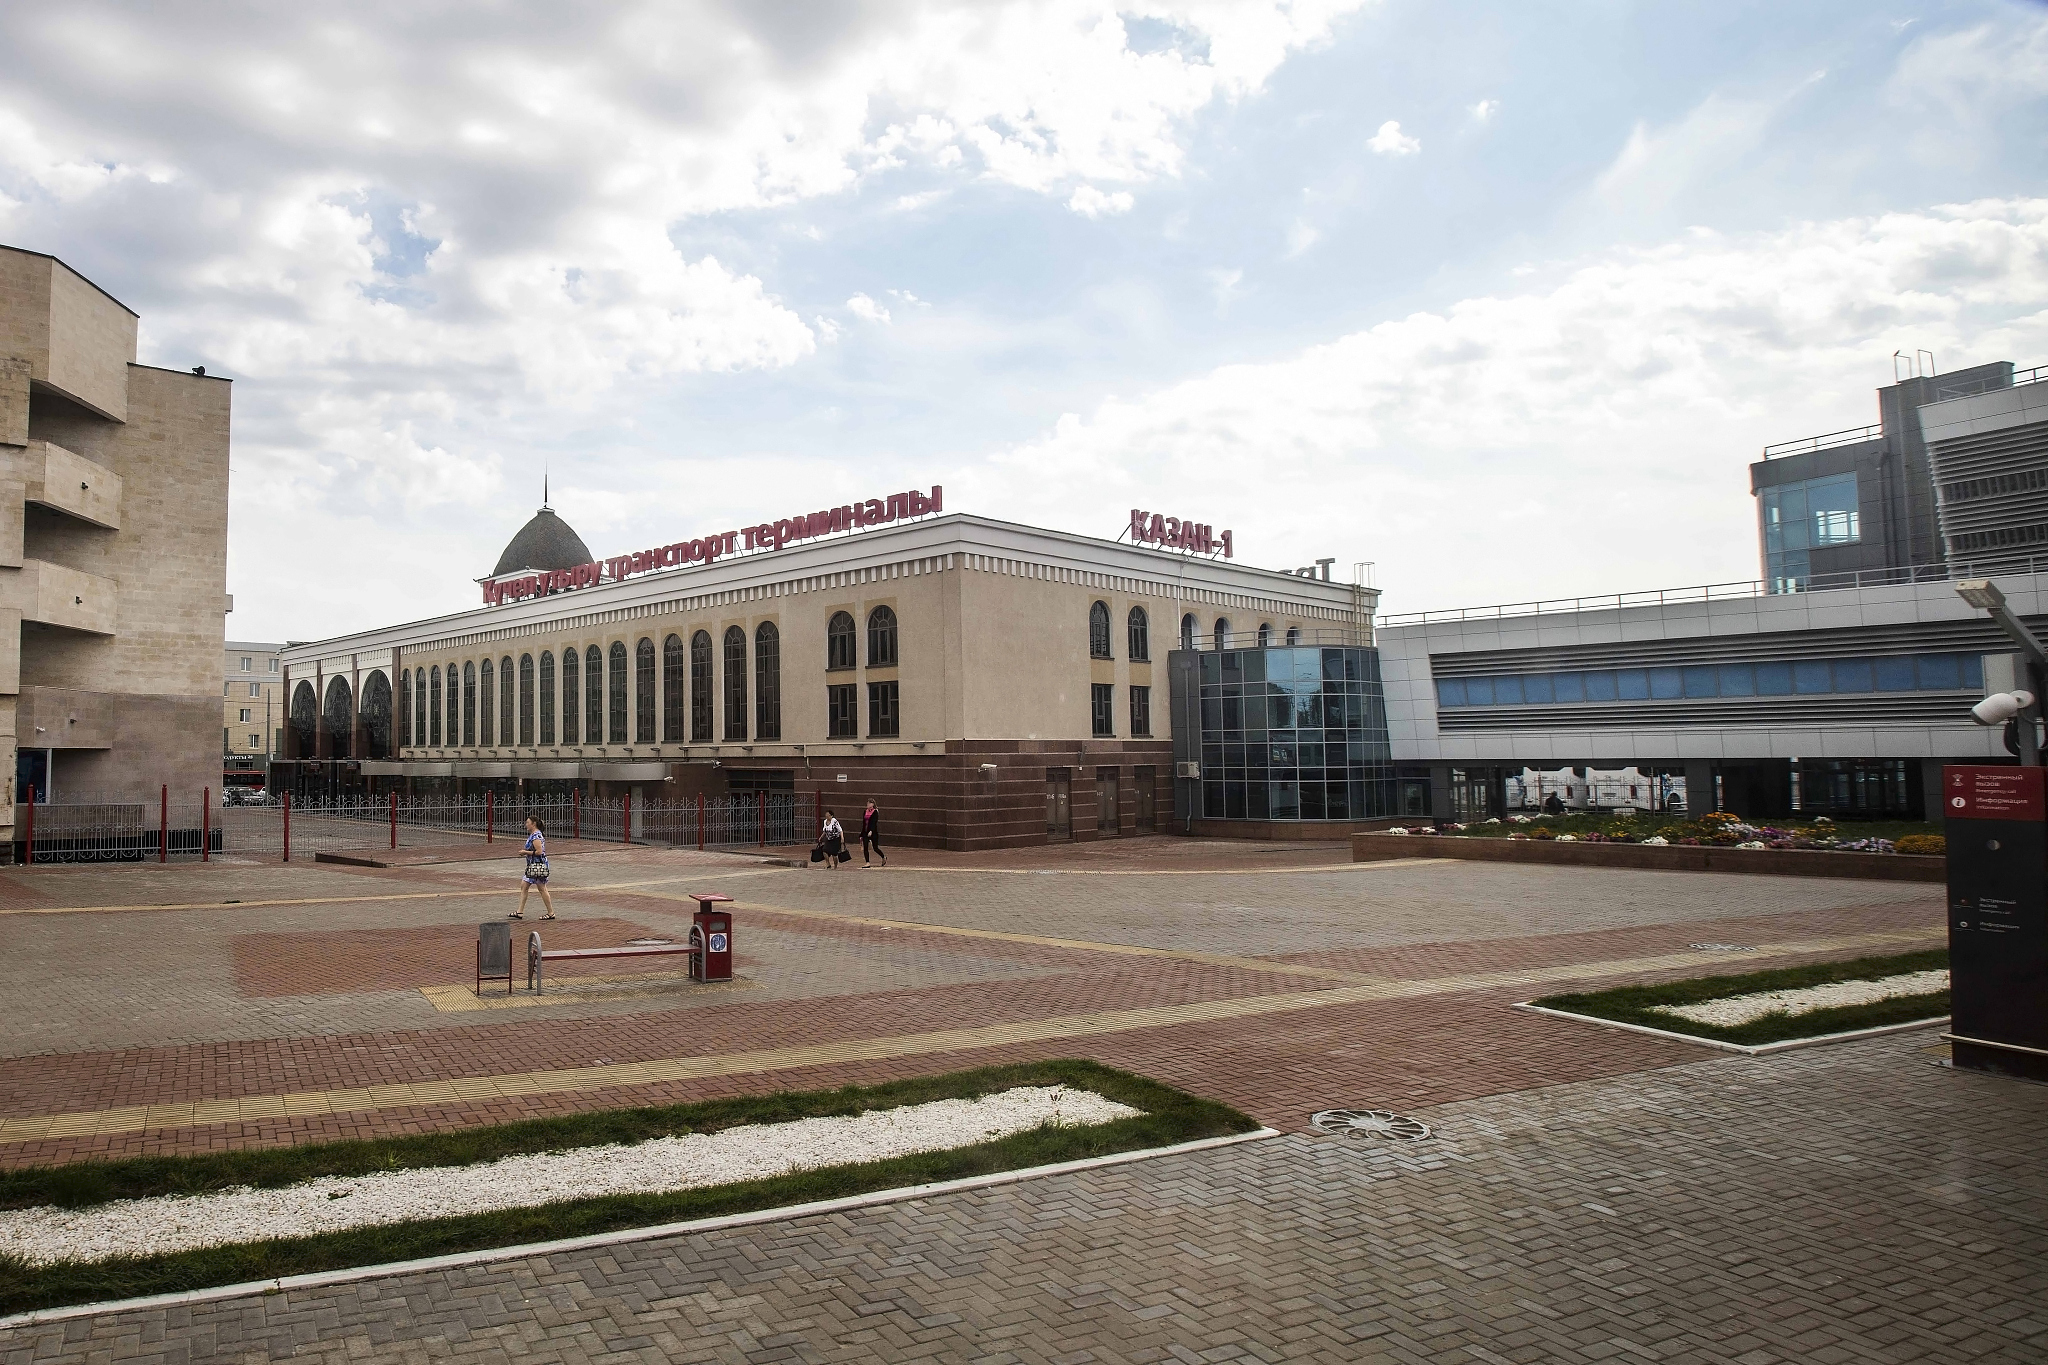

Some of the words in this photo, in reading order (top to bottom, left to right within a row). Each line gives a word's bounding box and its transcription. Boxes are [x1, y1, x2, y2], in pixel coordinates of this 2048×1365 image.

[538, 561, 603, 597] утыру
[605, 530, 737, 582] транспорт
[741, 485, 942, 550] терминалы
[1130, 509, 1233, 558] КАЗАН-1
